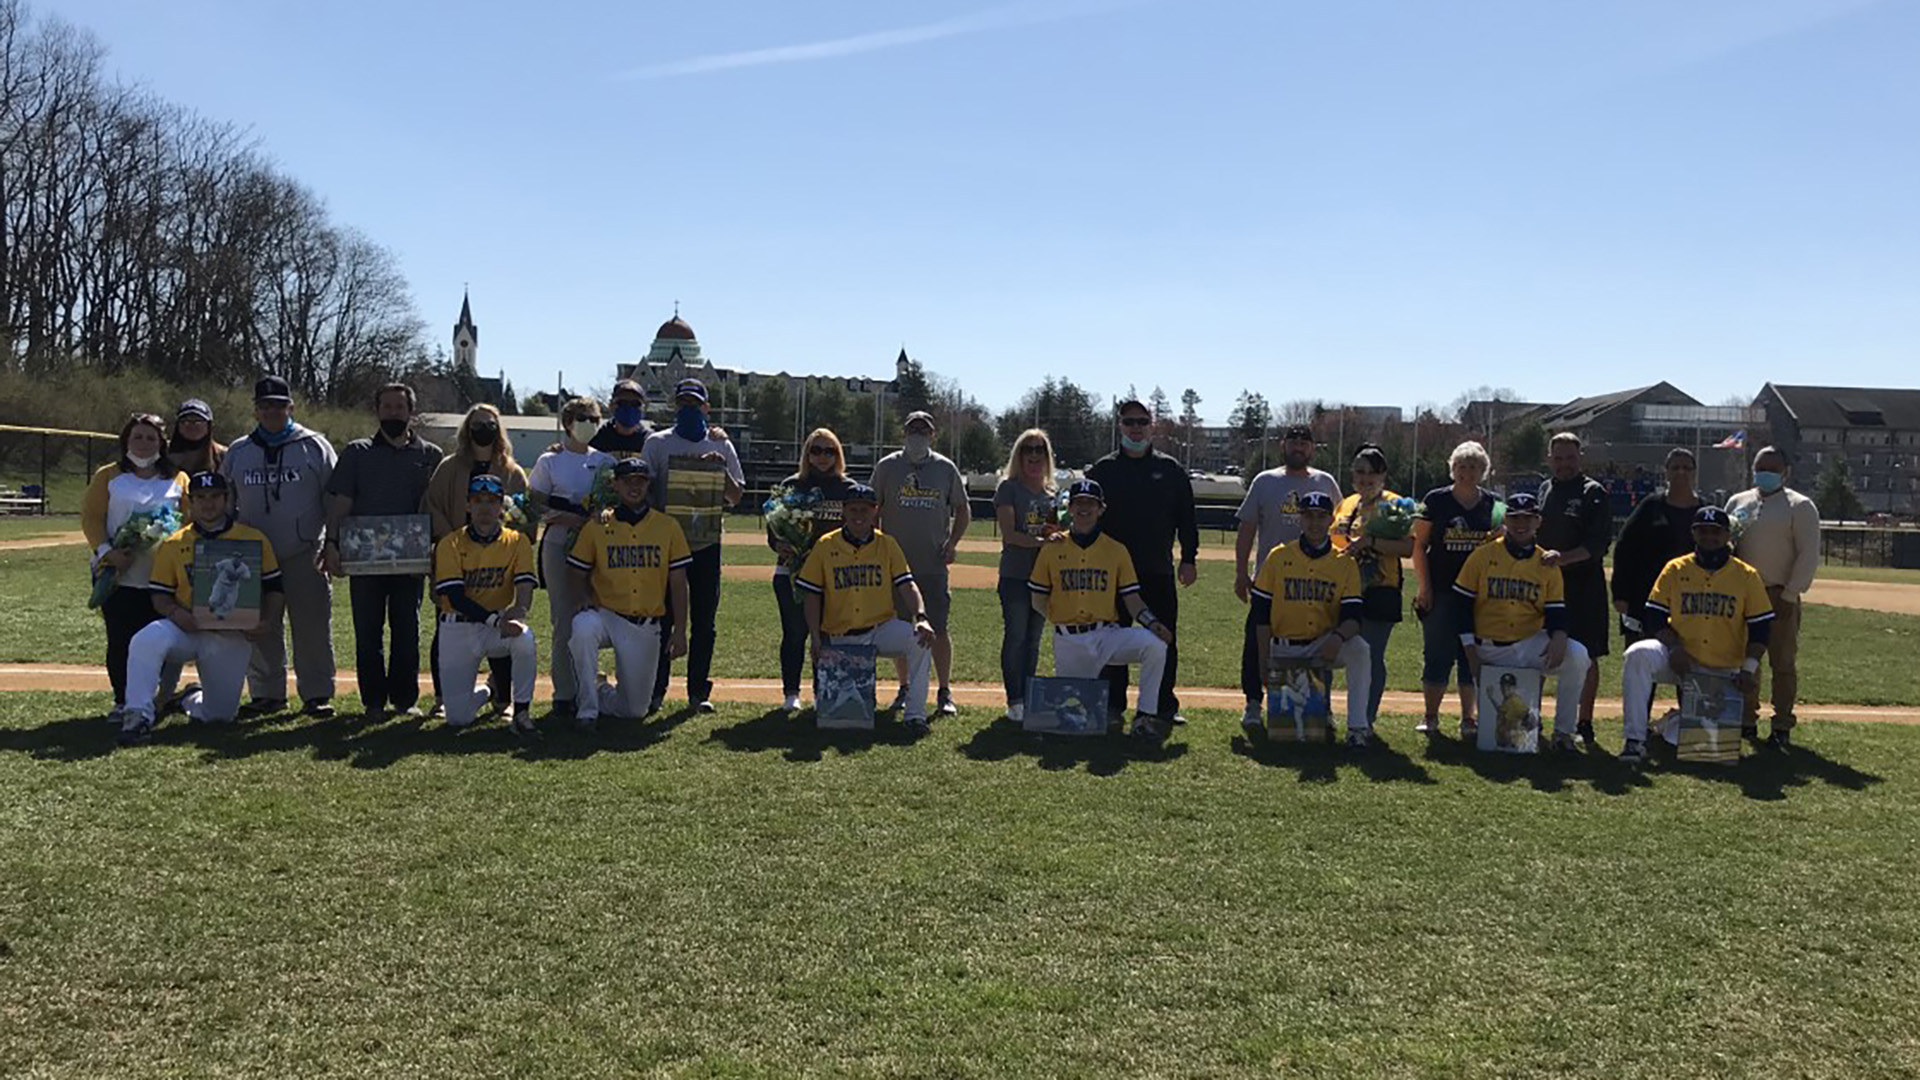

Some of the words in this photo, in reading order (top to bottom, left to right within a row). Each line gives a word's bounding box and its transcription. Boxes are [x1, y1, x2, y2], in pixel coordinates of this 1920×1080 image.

[201, 476, 212, 487] N
[1309, 495, 1321, 506] N
[1703, 510, 1716, 521] N
[607, 545, 660, 567] KNIGHTS
[834, 565, 881, 589] KNIGHTS
[1060, 569, 1107, 591] KNIGHTS
[1284, 577, 1335, 602] KNIGHTS
[1487, 577, 1540, 602] KNIGHTS
[1681, 591, 1737, 619] KNIGHTS
